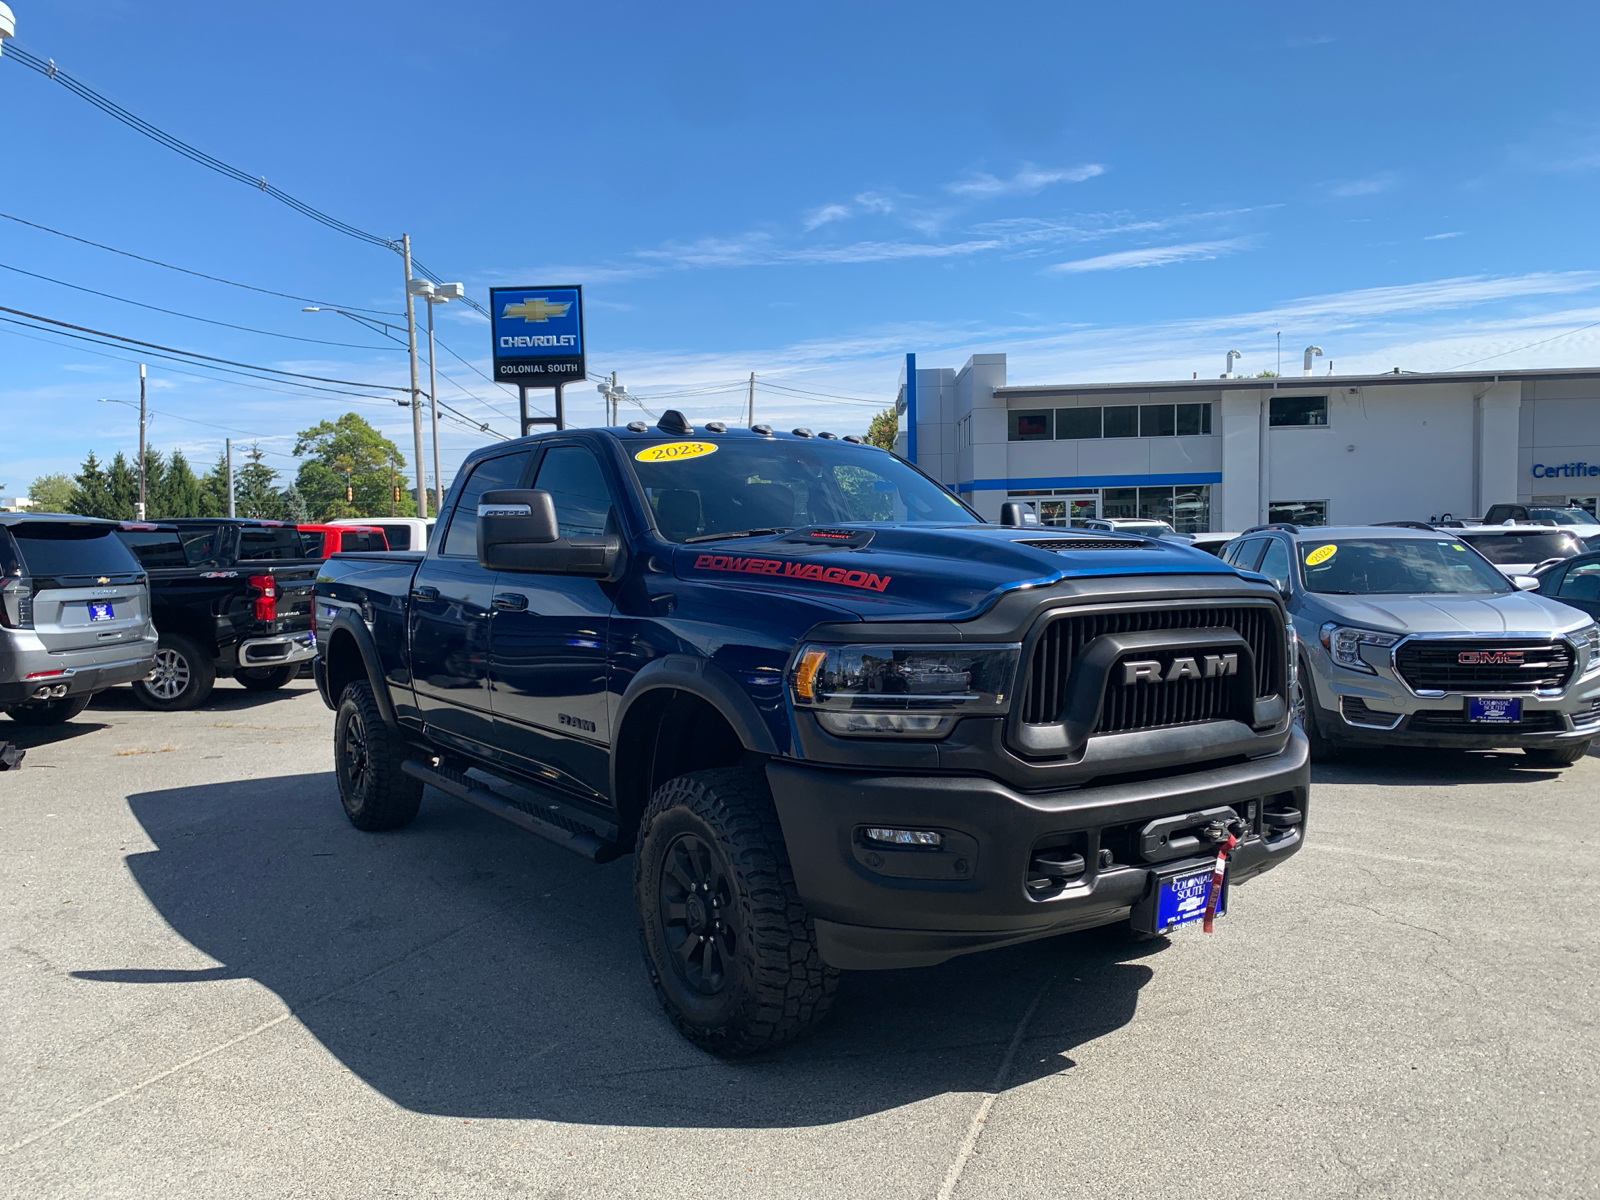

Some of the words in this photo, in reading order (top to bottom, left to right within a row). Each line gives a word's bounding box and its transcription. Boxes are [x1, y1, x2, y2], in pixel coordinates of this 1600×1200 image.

[500, 334, 576, 348] CHEVROLET
[500, 365, 545, 374] COLONIAL
[547, 363, 578, 373] SOUTH
[651, 442, 704, 460] 2023
[1532, 462, 1600, 479] Certifie
[1311, 546, 1333, 563] 2023
[693, 554, 783, 575] POWER
[785, 562, 892, 593] WAGON
[1458, 651, 1525, 664] GMC
[1122, 652, 1238, 686] RAM
[557, 712, 597, 733] RAM
[1171, 873, 1213, 892] COLONIAL
[1177, 884, 1206, 901] SOUTH
